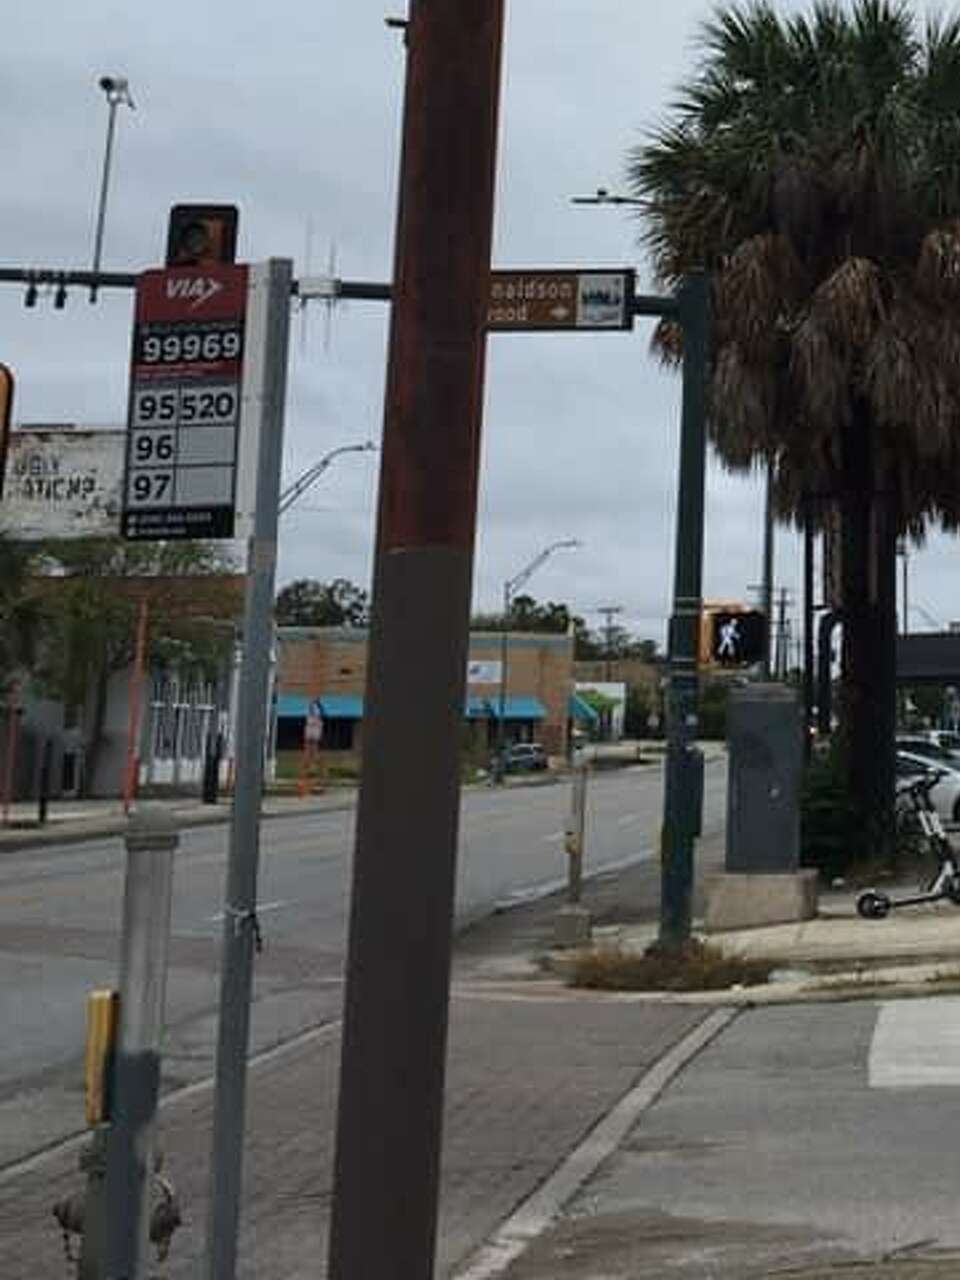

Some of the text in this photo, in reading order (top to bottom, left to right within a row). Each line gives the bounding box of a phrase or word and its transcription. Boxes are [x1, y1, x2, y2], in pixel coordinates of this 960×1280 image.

[166, 277, 211, 301] VIA
[491, 277, 572, 299] naldson
[144, 332, 240, 361] 99969
[140, 393, 233, 420] 95 520
[136, 434, 172, 460] 96
[133, 474, 170, 501] 97
